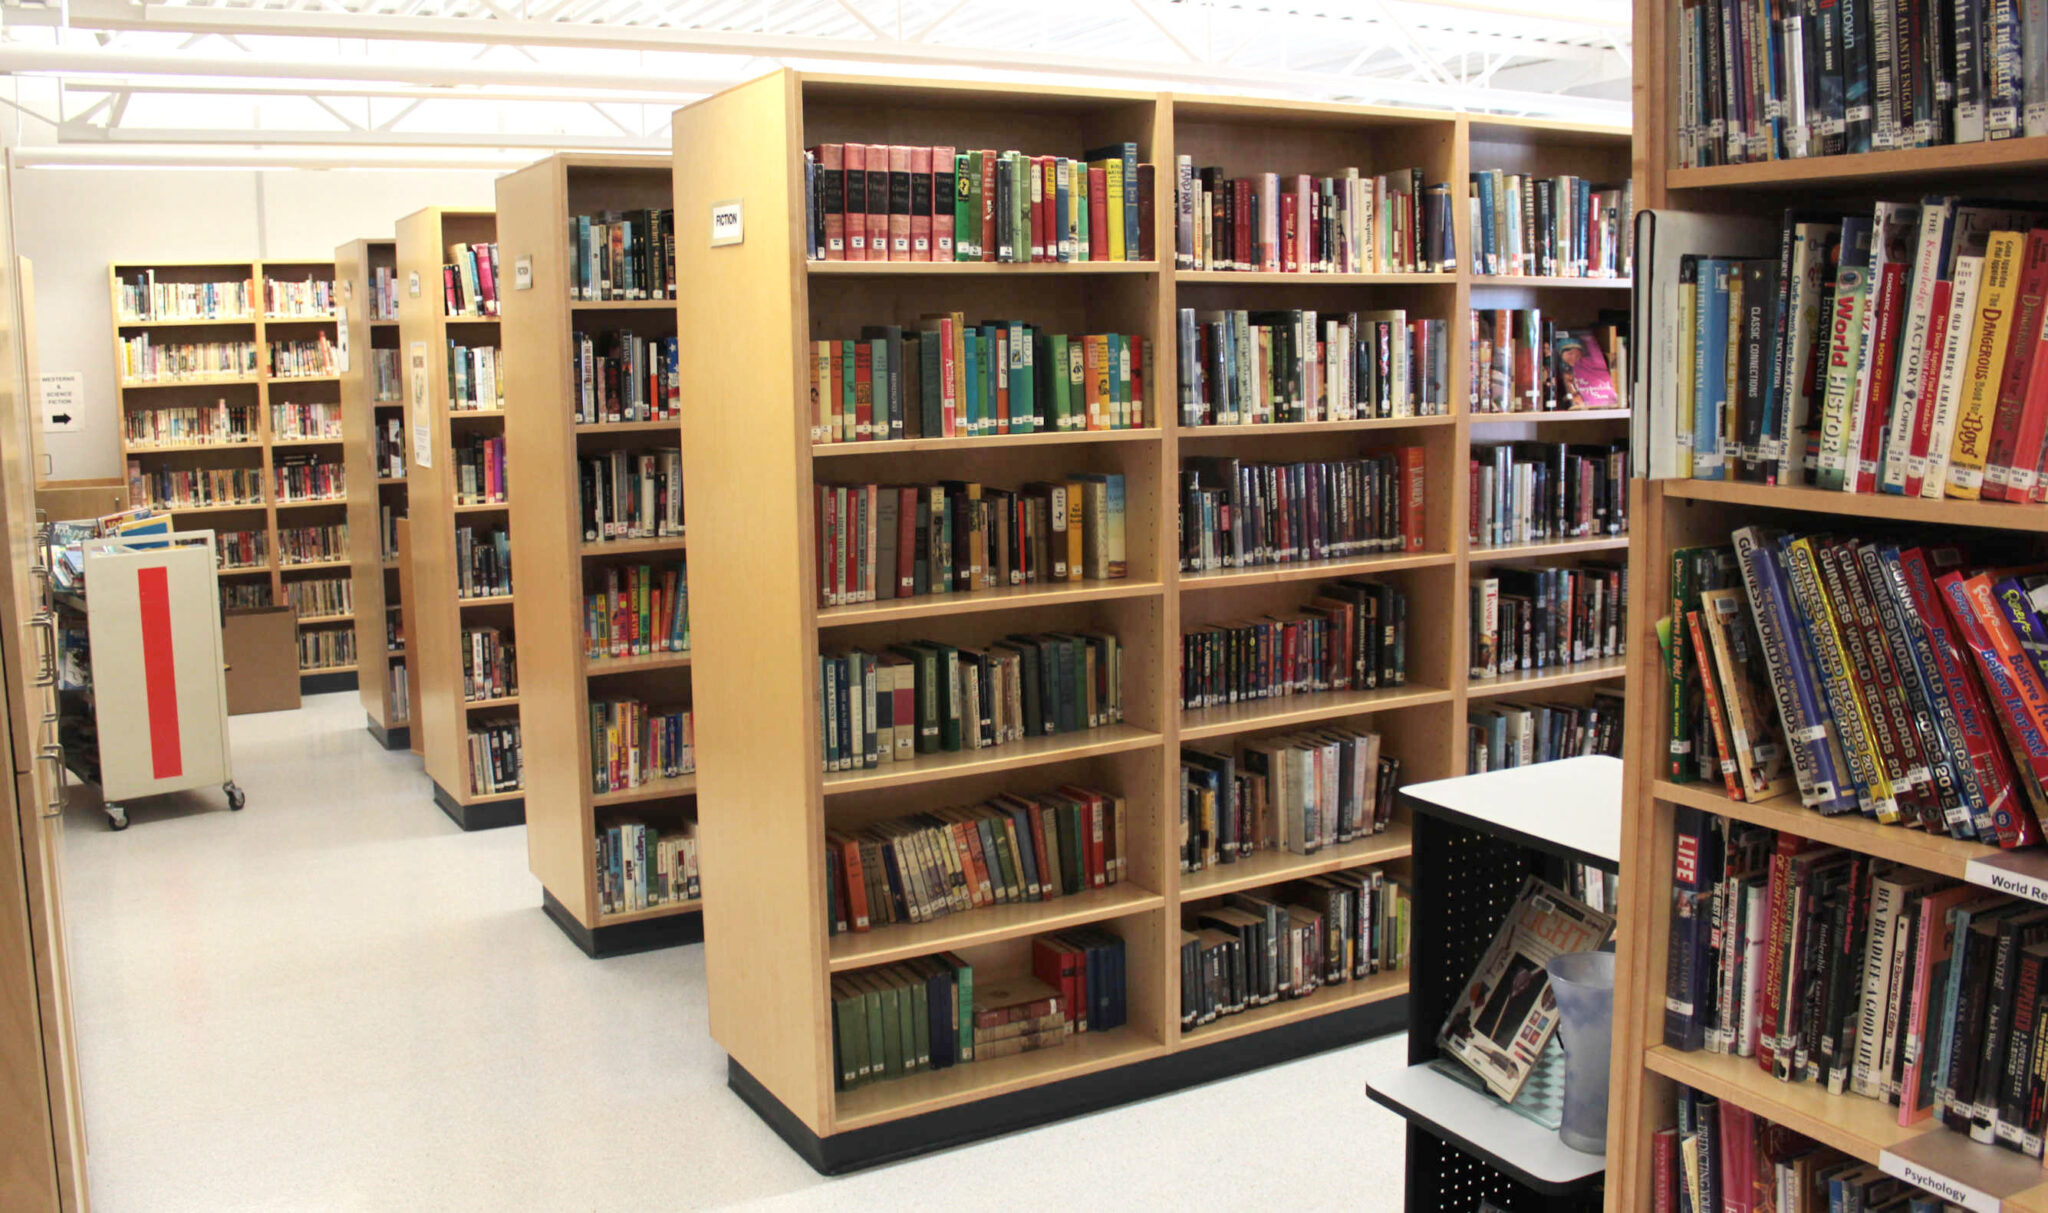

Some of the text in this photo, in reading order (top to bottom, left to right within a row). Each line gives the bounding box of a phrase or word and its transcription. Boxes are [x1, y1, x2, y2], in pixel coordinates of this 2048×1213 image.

[1998, 25, 2011, 50] THE
[1899, 15, 1913, 117] ATLANTIS ENIGMA
[1998, 52, 2012, 98] VALLEY
[1181, 164, 1192, 214] HARD RAIN
[716, 213, 737, 226] FICTION
[1365, 214, 1375, 244] Weeping
[1792, 275, 1800, 302] Charlie
[1868, 254, 1878, 281] TOP
[1790, 303, 1799, 332] Brown's
[1862, 300, 1873, 331] QUIZ
[1906, 212, 1938, 387] THE Knowledge FACTORY
[1989, 294, 2000, 307] The
[1816, 297, 1834, 390] Encyclopedia
[1872, 272, 1893, 401] SCHOLASTIC CANADA BOOK OF LISTS
[1936, 315, 1944, 331] How
[1974, 308, 2002, 380] DANGEROUS
[1749, 306, 1761, 398] CLASSIC CONNECTIONS
[1774, 337, 1784, 388] ENCYCLOPEDIA
[1787, 357, 1795, 376] Book
[1822, 296, 1854, 453] World HISTOR
[1857, 334, 1869, 371] BOOK
[1937, 292, 1965, 426] THE OLD FARMER'S ALMANAC
[1787, 377, 1793, 386] of
[1927, 376, 1936, 391] Find
[1783, 387, 1793, 424] Questions
[1782, 426, 1790, 440] and
[1959, 413, 1983, 459] Boys
[1674, 599, 1684, 635] Believe
[1738, 537, 1808, 770] GUINNESS WORLD RECORDS 2003
[1797, 549, 1878, 785] GUINNESS WORLD RECORDS 2016
[1820, 549, 1895, 755] GUINNESS WORLD RECORDS
[1839, 550, 1917, 759] GUINNESS WORLD RECORDS
[1931, 627, 1956, 674] Believe
[1789, 680, 1801, 708] WORLD
[1863, 552, 1958, 808] GUINNESS WORLD RECORDS 2012
[1889, 560, 1983, 808] GUINNESS WORLD RECORDS 2015
[1954, 691, 1966, 706] or
[2008, 655, 2041, 701] Believe
[1808, 623, 1831, 674] WORLD
[1822, 677, 1854, 748] RECORDS
[1848, 750, 1866, 784] 2015
[1959, 708, 1981, 737] Not!
[1980, 649, 2012, 697] Believe
[2013, 712, 2028, 727] or
[2021, 728, 2048, 758] Not!
[1677, 835, 1696, 881] LIFE
[1876, 888, 1890, 914] BEN
[1991, 875, 2028, 896] World
[1520, 907, 1592, 951] LIGHT
[1711, 882, 1722, 948] THE BEST OF LIFE
[1766, 854, 1785, 995] OF LIGHT CONSTRUCTION
[1816, 924, 1828, 973] Intolerable
[1869, 918, 1886, 982] BRADLEE
[1896, 950, 1904, 964] The
[1891, 966, 1901, 1000] Elements
[1863, 999, 1877, 1036] GOOD
[1886, 1011, 1896, 1039] Editing
[1890, 1002, 1896, 1011] of
[2008, 1030, 2020, 1076] SILENCED
[2013, 1041, 2027, 1098] JOURNALIST
[1698, 1124, 1710, 1187] PREDICTING
[1905, 1166, 1967, 1203] Psychology
